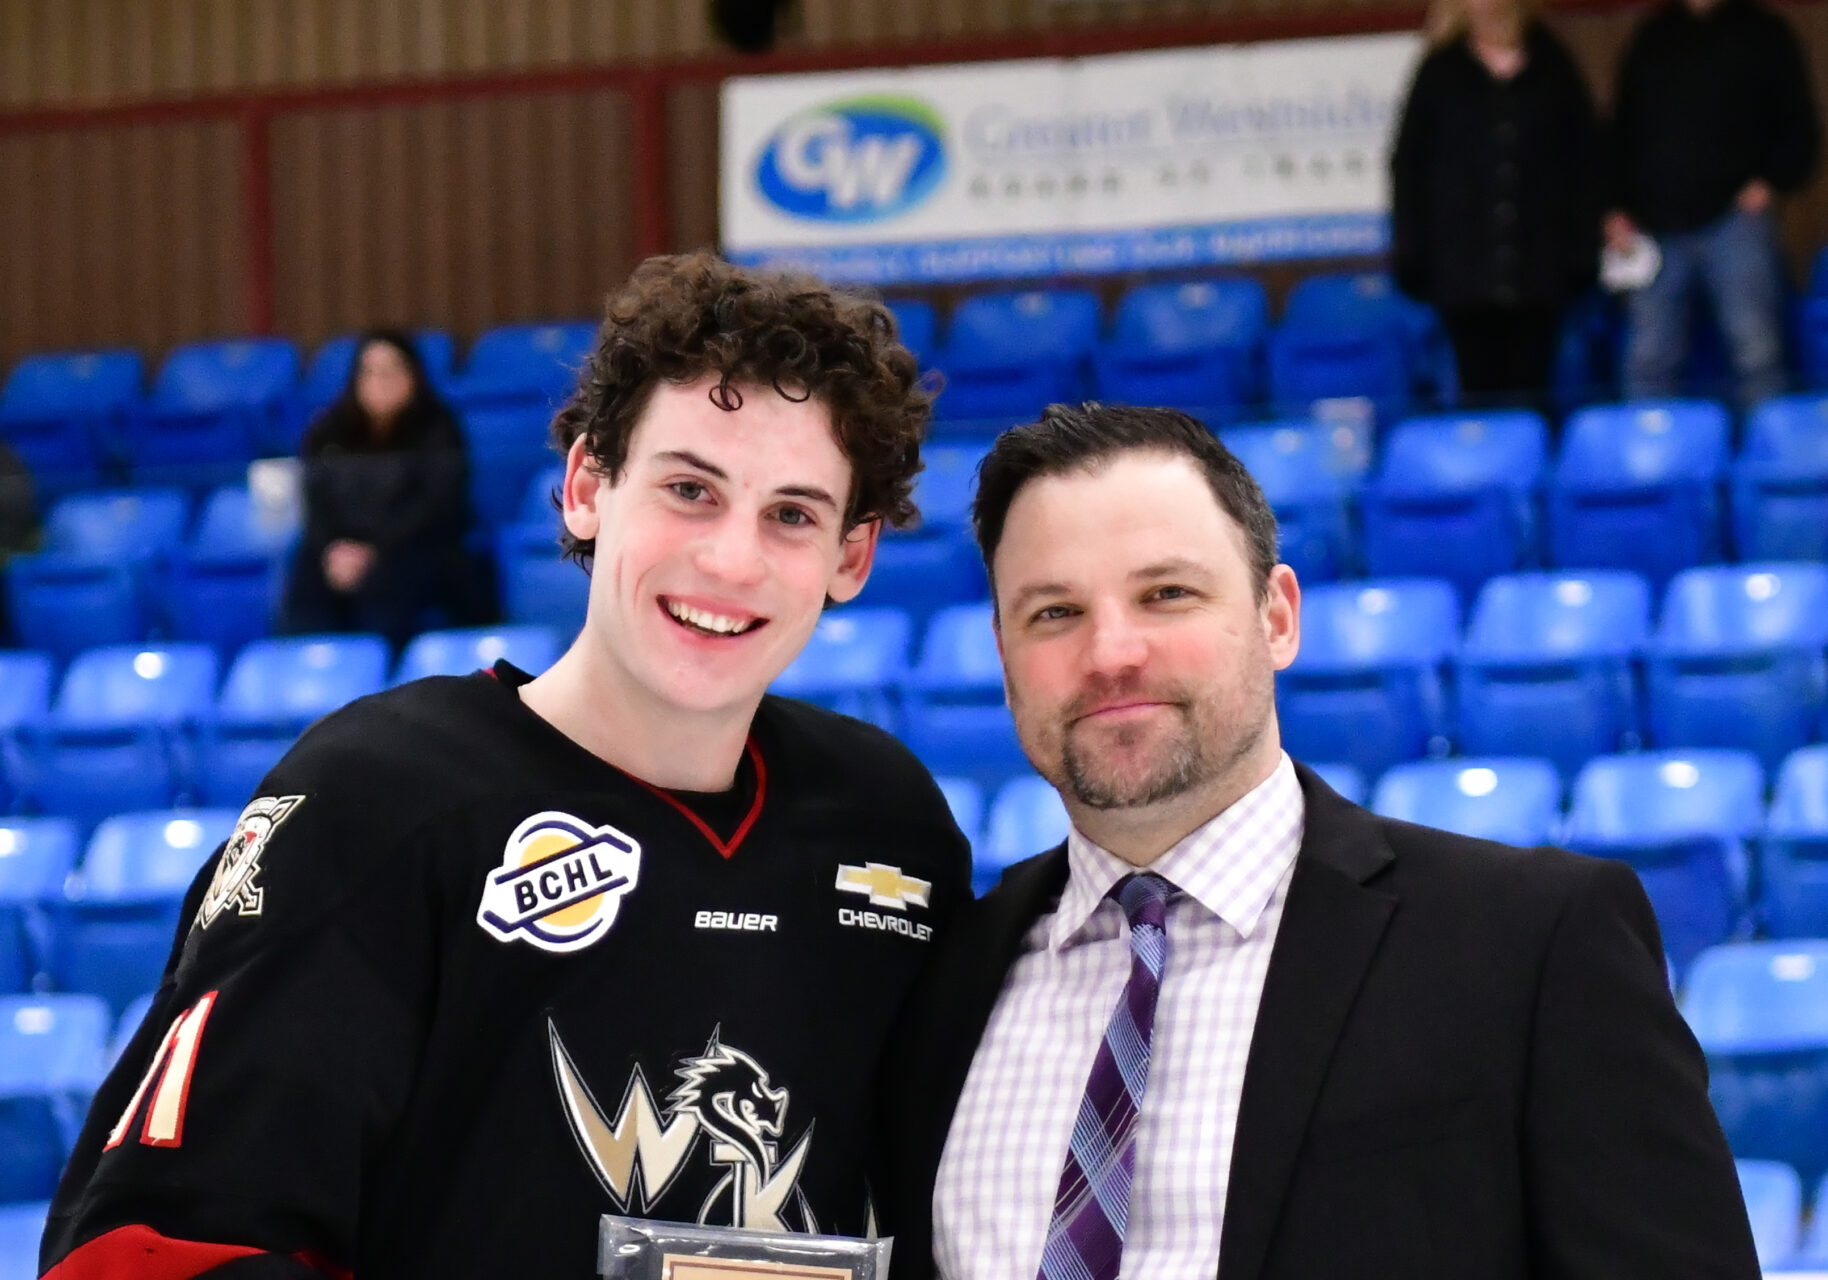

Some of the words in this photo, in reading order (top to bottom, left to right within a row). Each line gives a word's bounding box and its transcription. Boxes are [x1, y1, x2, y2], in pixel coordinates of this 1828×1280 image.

[772, 112, 920, 206] GW
[513, 852, 614, 914] BCHL
[694, 910, 777, 932] BAUER
[838, 908, 934, 942] CHEVROLET
